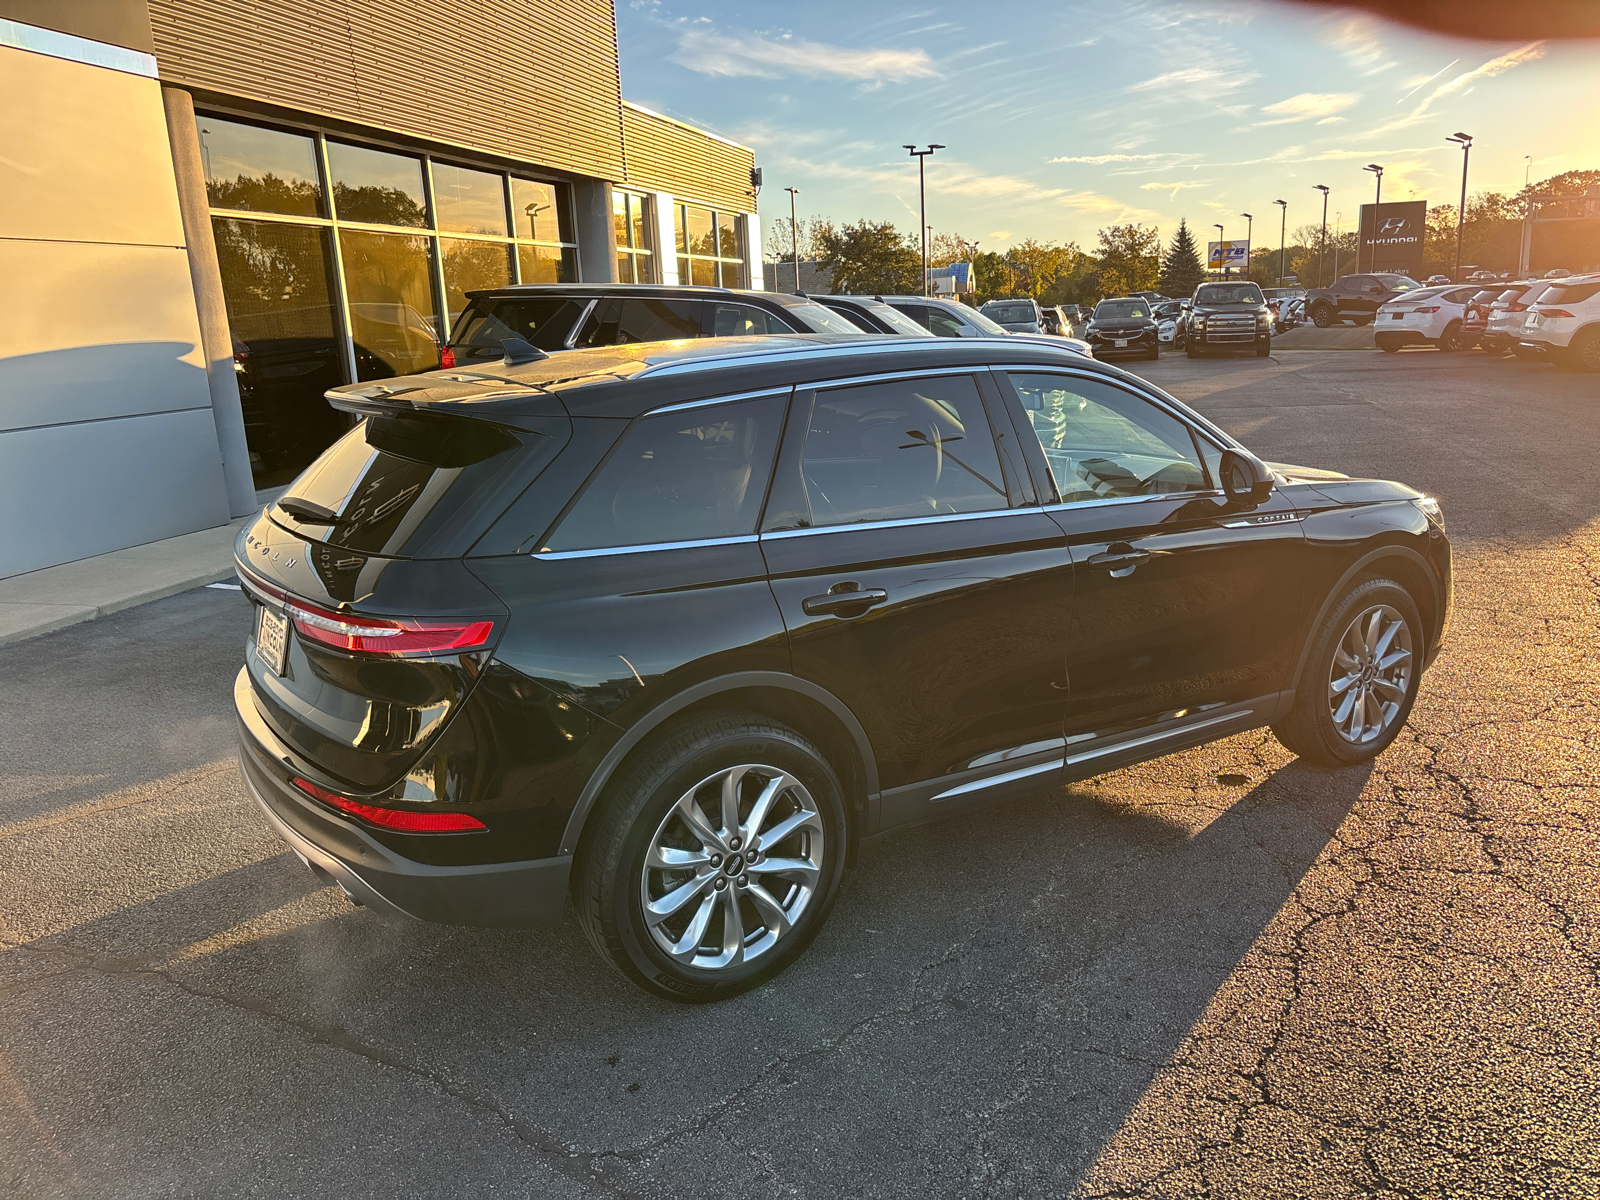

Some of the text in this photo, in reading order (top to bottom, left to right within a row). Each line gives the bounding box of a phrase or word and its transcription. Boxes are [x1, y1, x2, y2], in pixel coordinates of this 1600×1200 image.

[1366, 236, 1418, 246] HYUNDAI
[1213, 248, 1245, 256] NTB
[1257, 513, 1295, 523] CORSAIR
[241, 526, 297, 569] LINCOLN
[804, 760, 823, 777] TOUR
